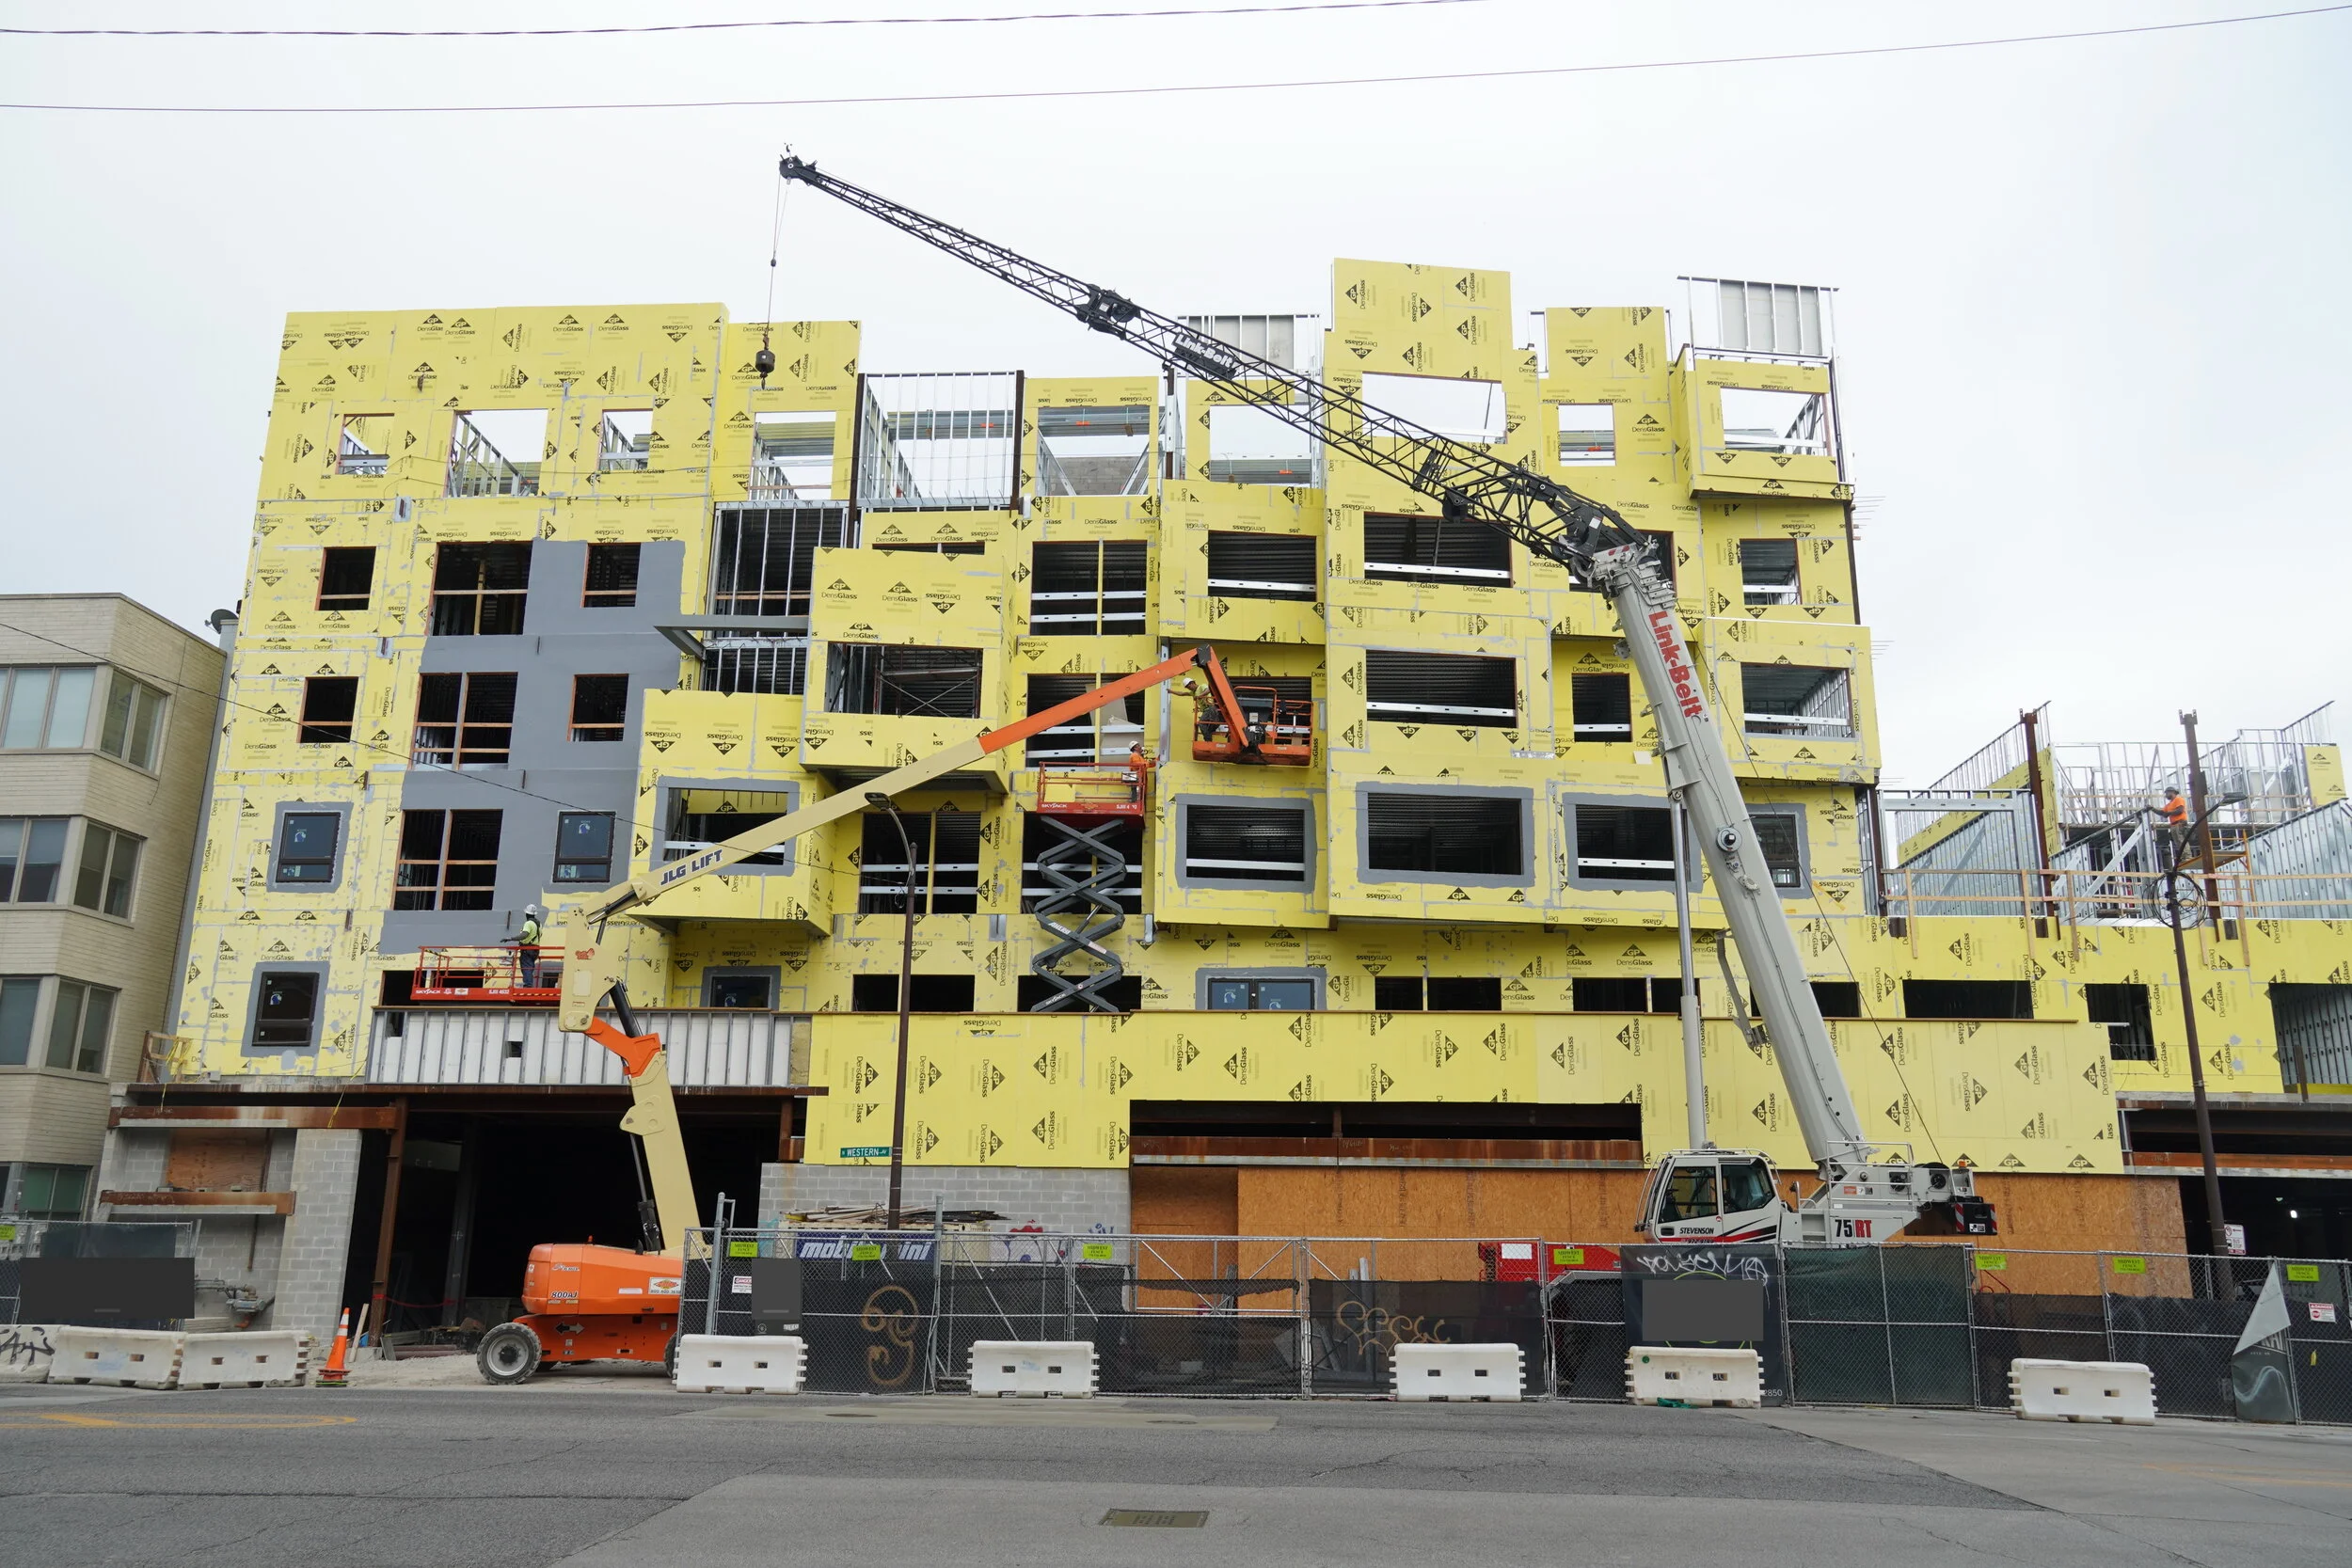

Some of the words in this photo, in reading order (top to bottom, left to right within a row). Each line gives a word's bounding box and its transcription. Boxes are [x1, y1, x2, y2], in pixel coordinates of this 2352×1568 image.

[1174, 333, 1233, 368] Link-Belt
[1648, 610, 1703, 718] Link-Belt
[203, 839, 213, 871] DensGlass
[660, 864, 687, 886] JLG
[691, 848, 723, 872] LIFT
[351, 927, 360, 961] DensGlass
[1045, 993, 1066, 1006] SKYJACK
[2217, 982, 2225, 1017] DensGlass
[346, 1024, 356, 1059] DensGlass
[2100, 1055, 2108, 1095] DensGlass
[2225, 1044, 2233, 1080] DensGlass
[847, 1148, 880, 1157] WESTERN
[1679, 1227, 1714, 1235] STEVENSON
[1835, 1219, 1852, 1238] 75
[1855, 1219, 1872, 1238] RT
[550, 1291, 578, 1299] 800AJ
